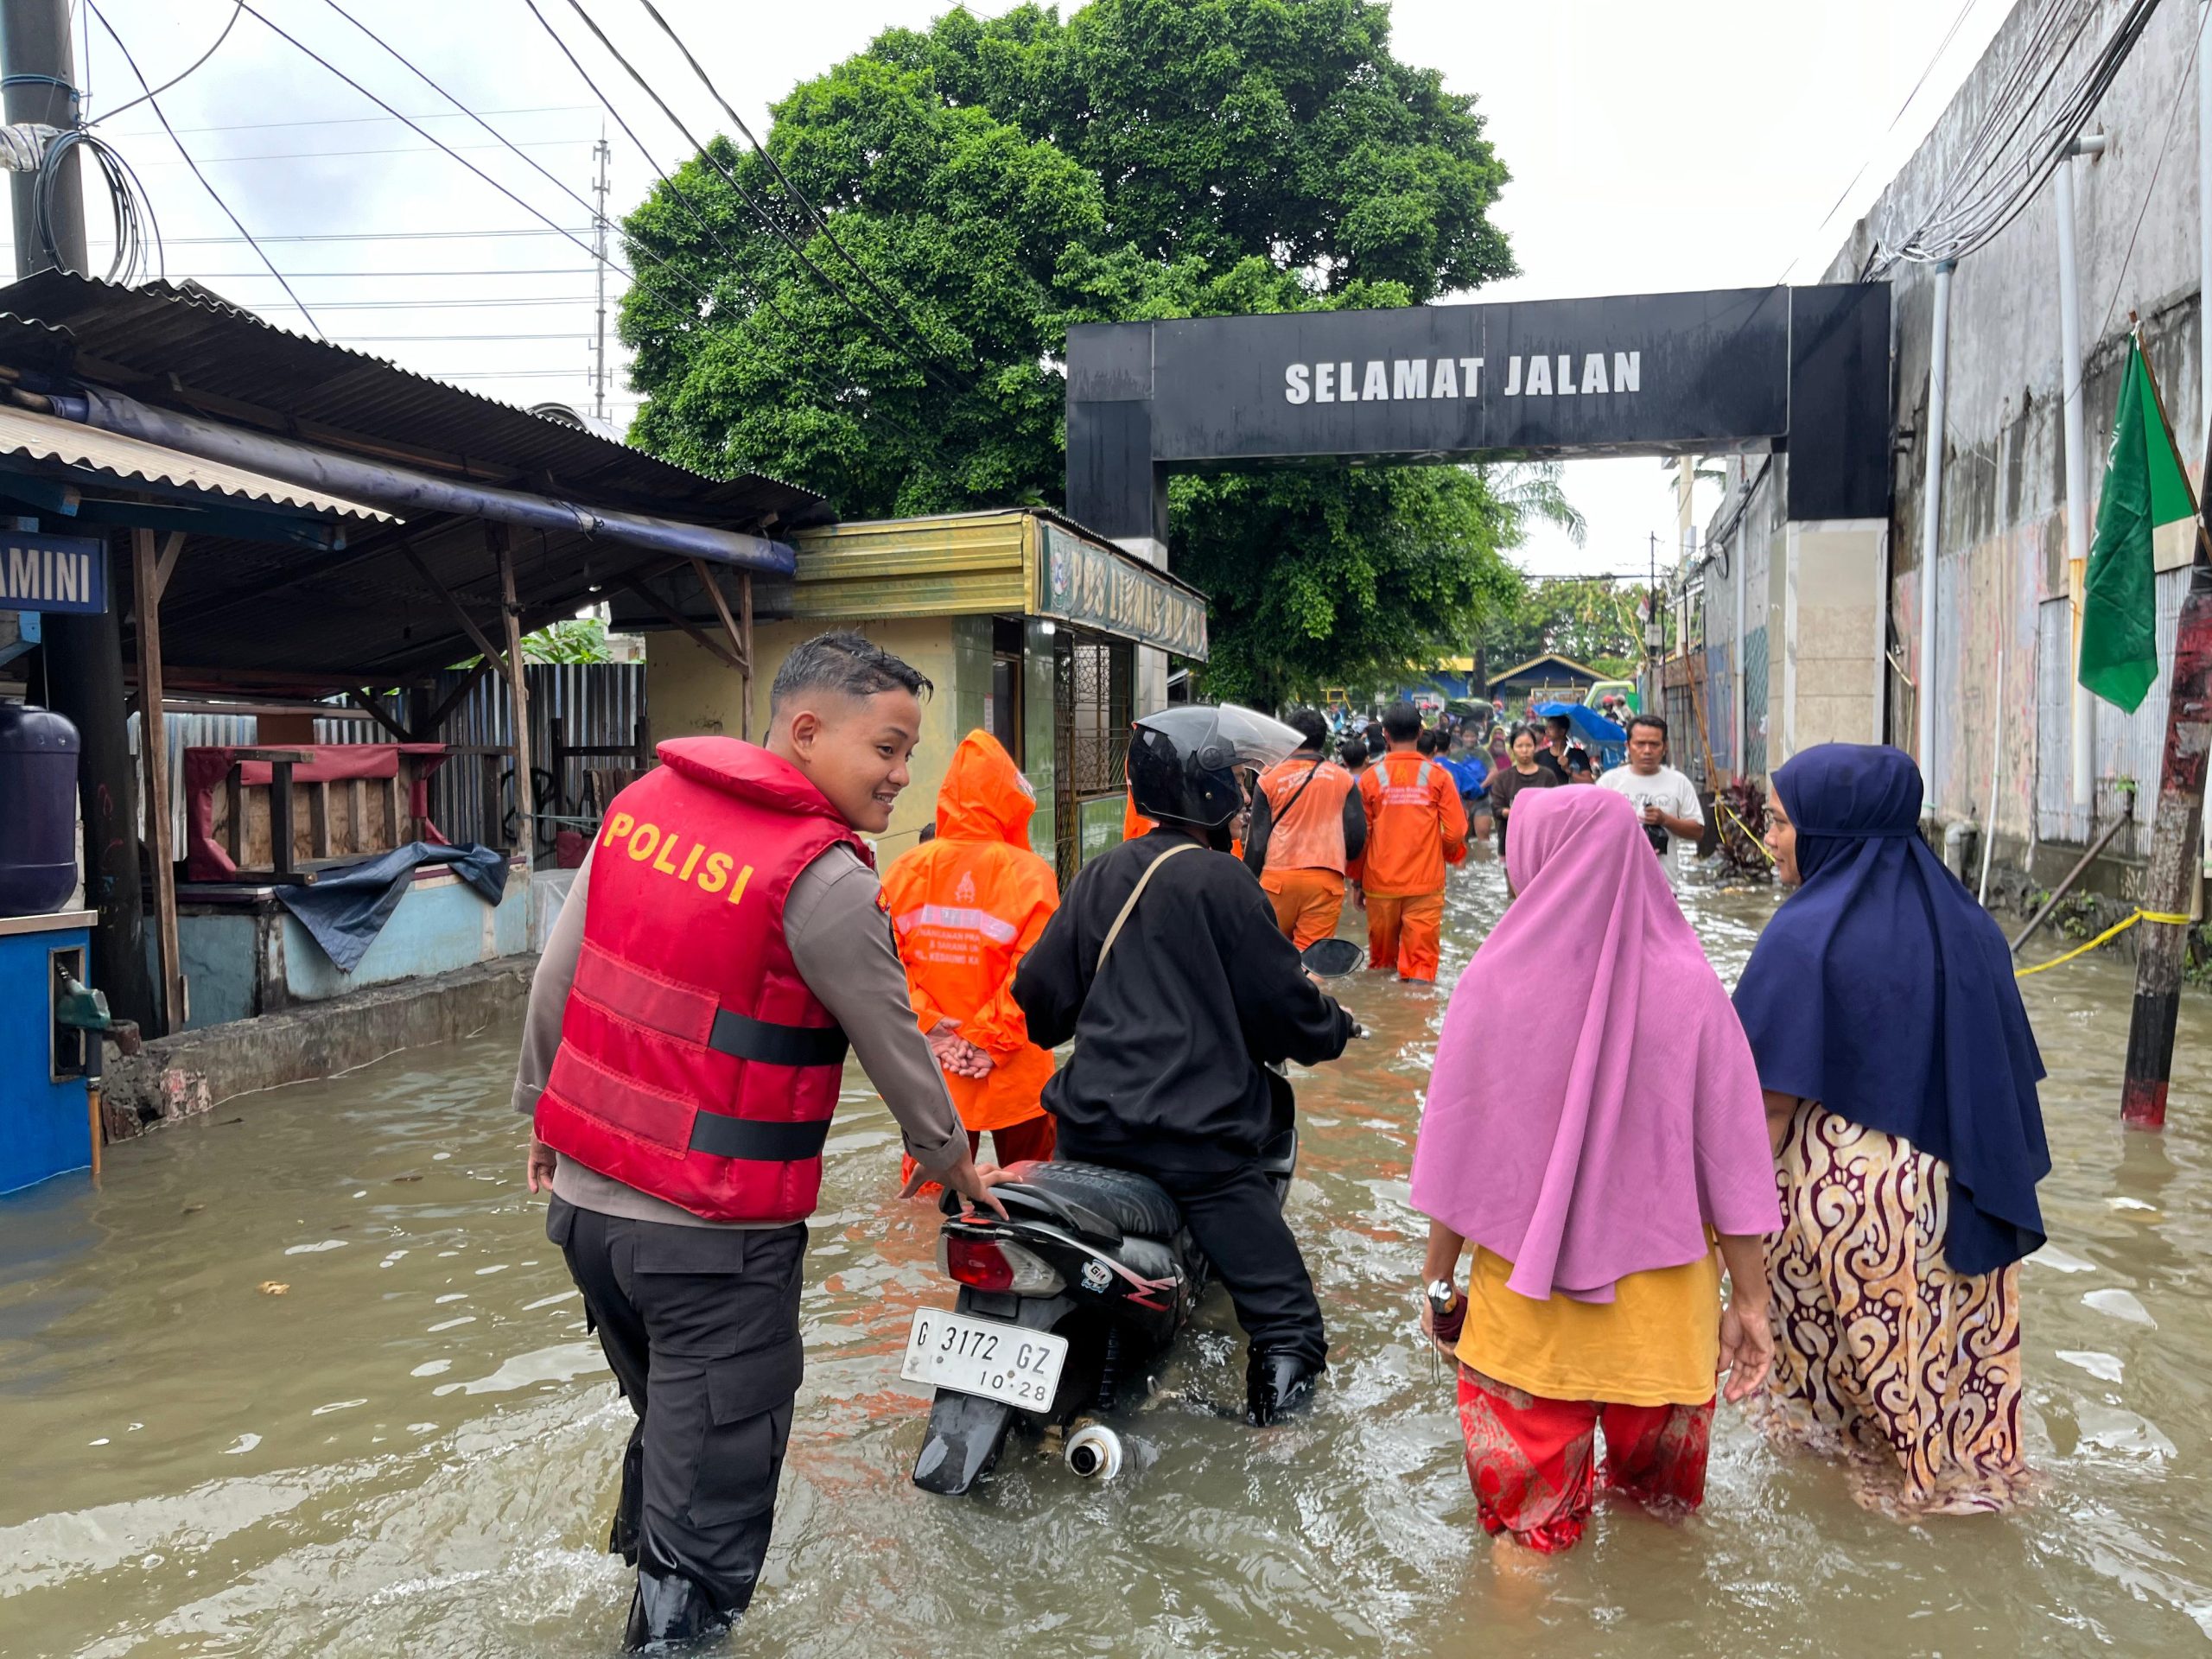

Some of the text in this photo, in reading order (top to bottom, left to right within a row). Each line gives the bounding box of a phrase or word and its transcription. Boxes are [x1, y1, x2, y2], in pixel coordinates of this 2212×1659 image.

[1285, 351, 1641, 404] SELAMAT JALAN
[602, 811, 754, 905] POLISI
[918, 1321, 1050, 1375] G 3172 GZ
